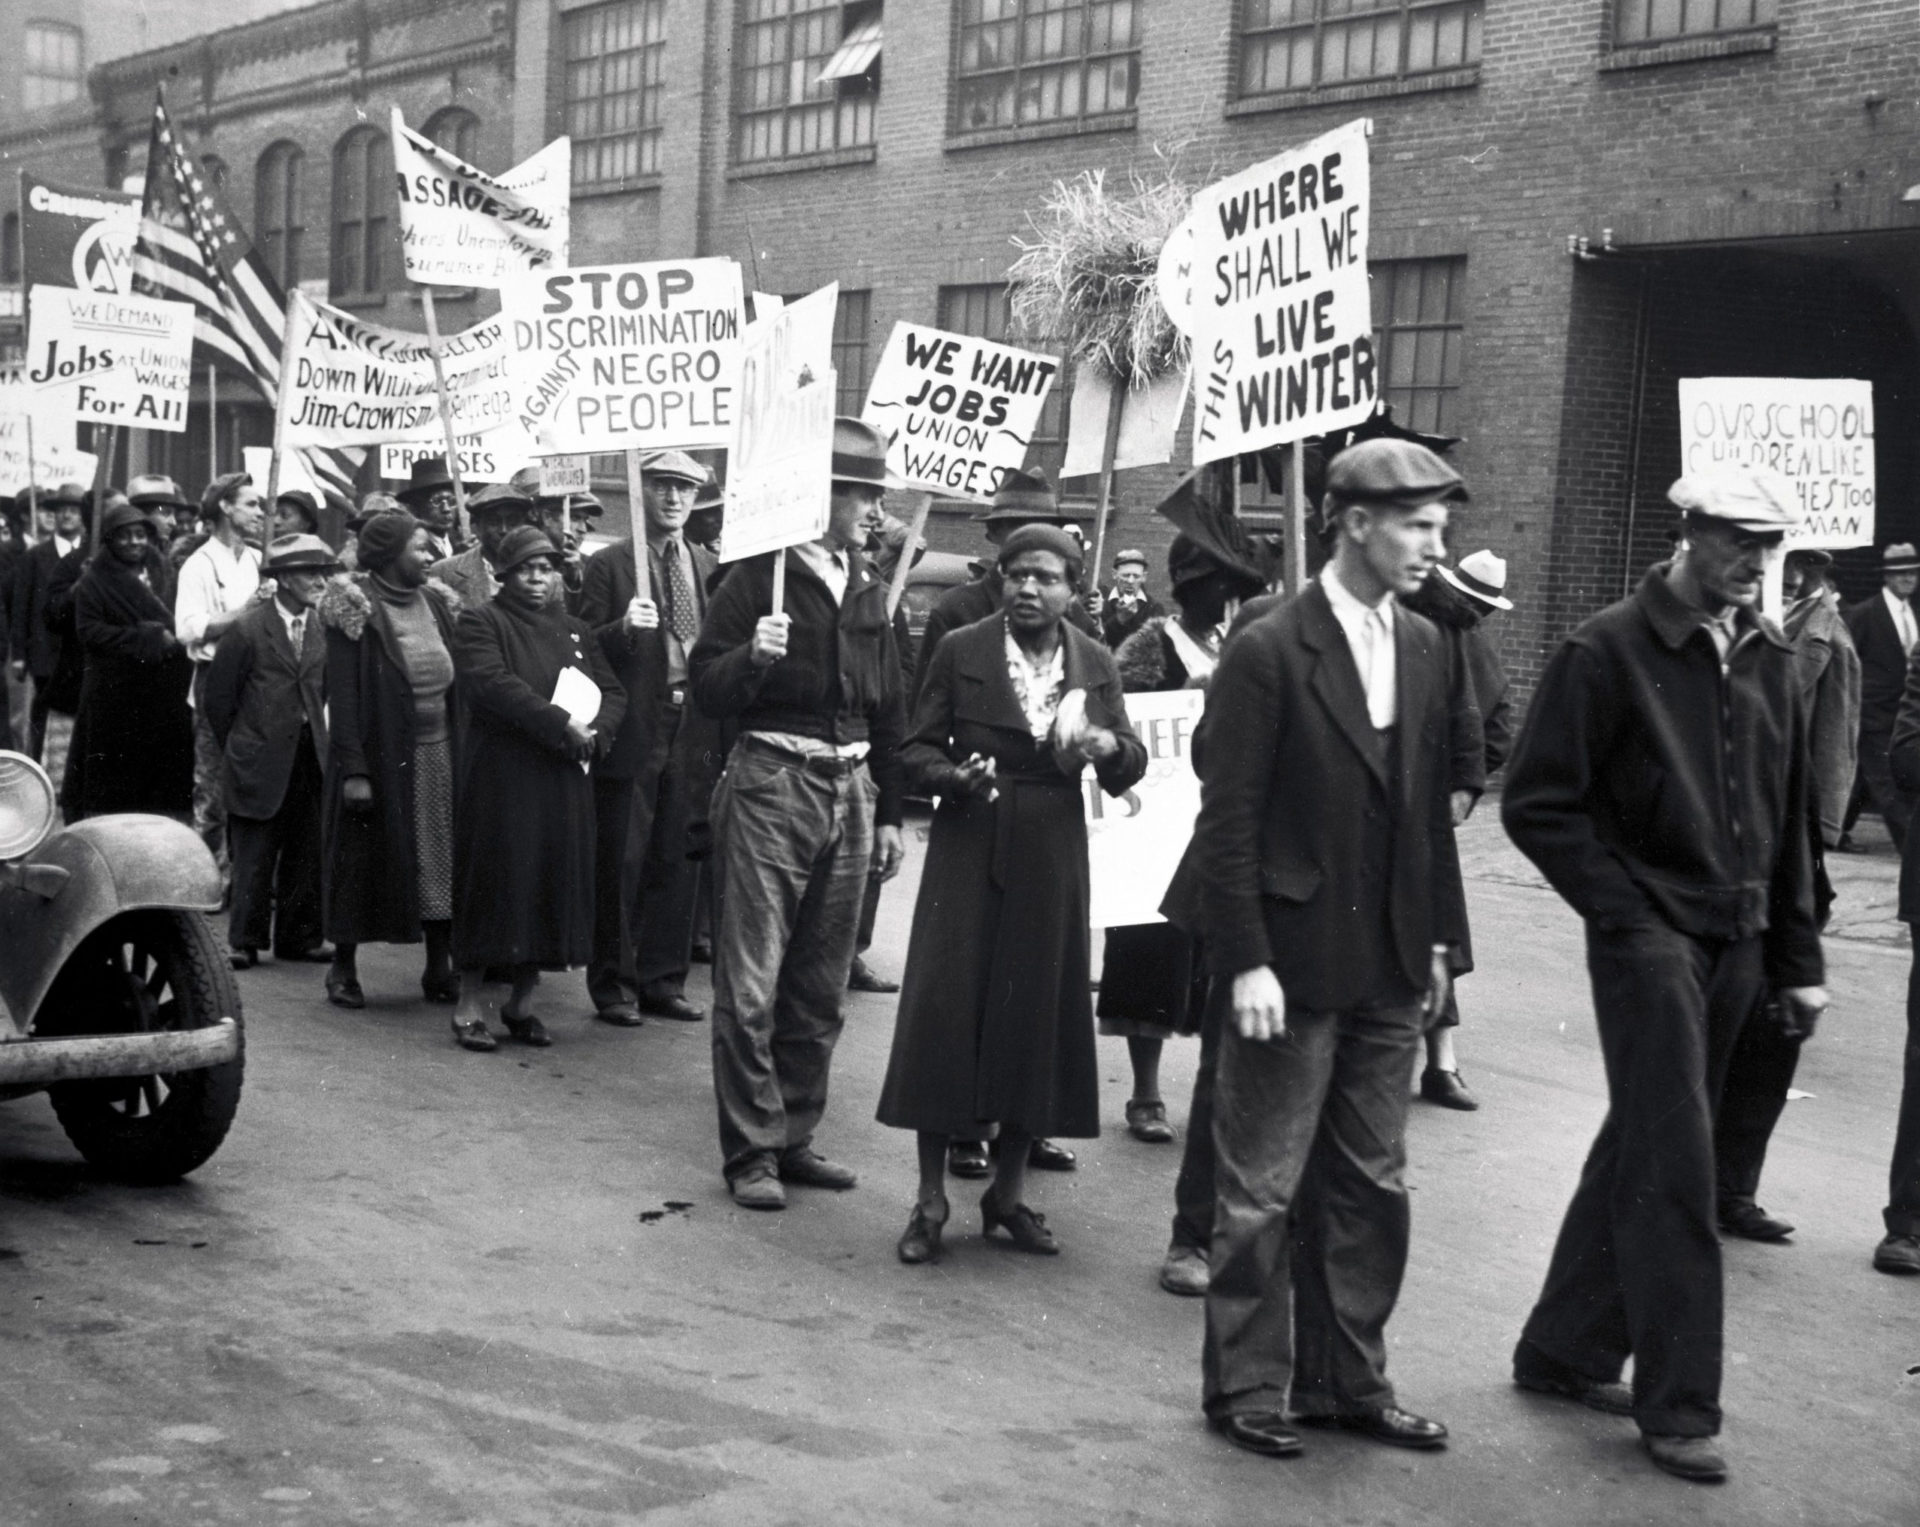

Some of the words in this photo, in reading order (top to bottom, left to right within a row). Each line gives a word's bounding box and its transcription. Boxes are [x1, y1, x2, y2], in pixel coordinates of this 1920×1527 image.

[1218, 152, 1344, 240] WHERE
[1214, 227, 1312, 307] SHALL
[1321, 204, 1361, 272] WE
[67, 296, 98, 320] WE
[106, 302, 173, 328] DEMAND
[543, 269, 694, 314] STOP
[513, 308, 738, 351] DISCRIMINATION
[1254, 290, 1336, 359] LIVE
[30, 339, 114, 383] Jobs
[296, 357, 356, 393] Down
[593, 349, 721, 386] NEGRO
[906, 332, 962, 376] WE
[970, 349, 1057, 396] WANT
[78, 384, 125, 414] For
[134, 394, 182, 421] All
[519, 349, 581, 434] AGAINST
[577, 386, 732, 435] PEOPLE
[905, 379, 1010, 426] JOBS
[1198, 339, 1234, 444] THIS
[1236, 335, 1377, 433] WINTER
[906, 412, 988, 452] UNION
[1760, 403, 1874, 441] SCHOOL
[387, 448, 496, 474] PROMSES
[904, 443, 1005, 497] WAGES
[1819, 441, 1865, 476] LIKE
